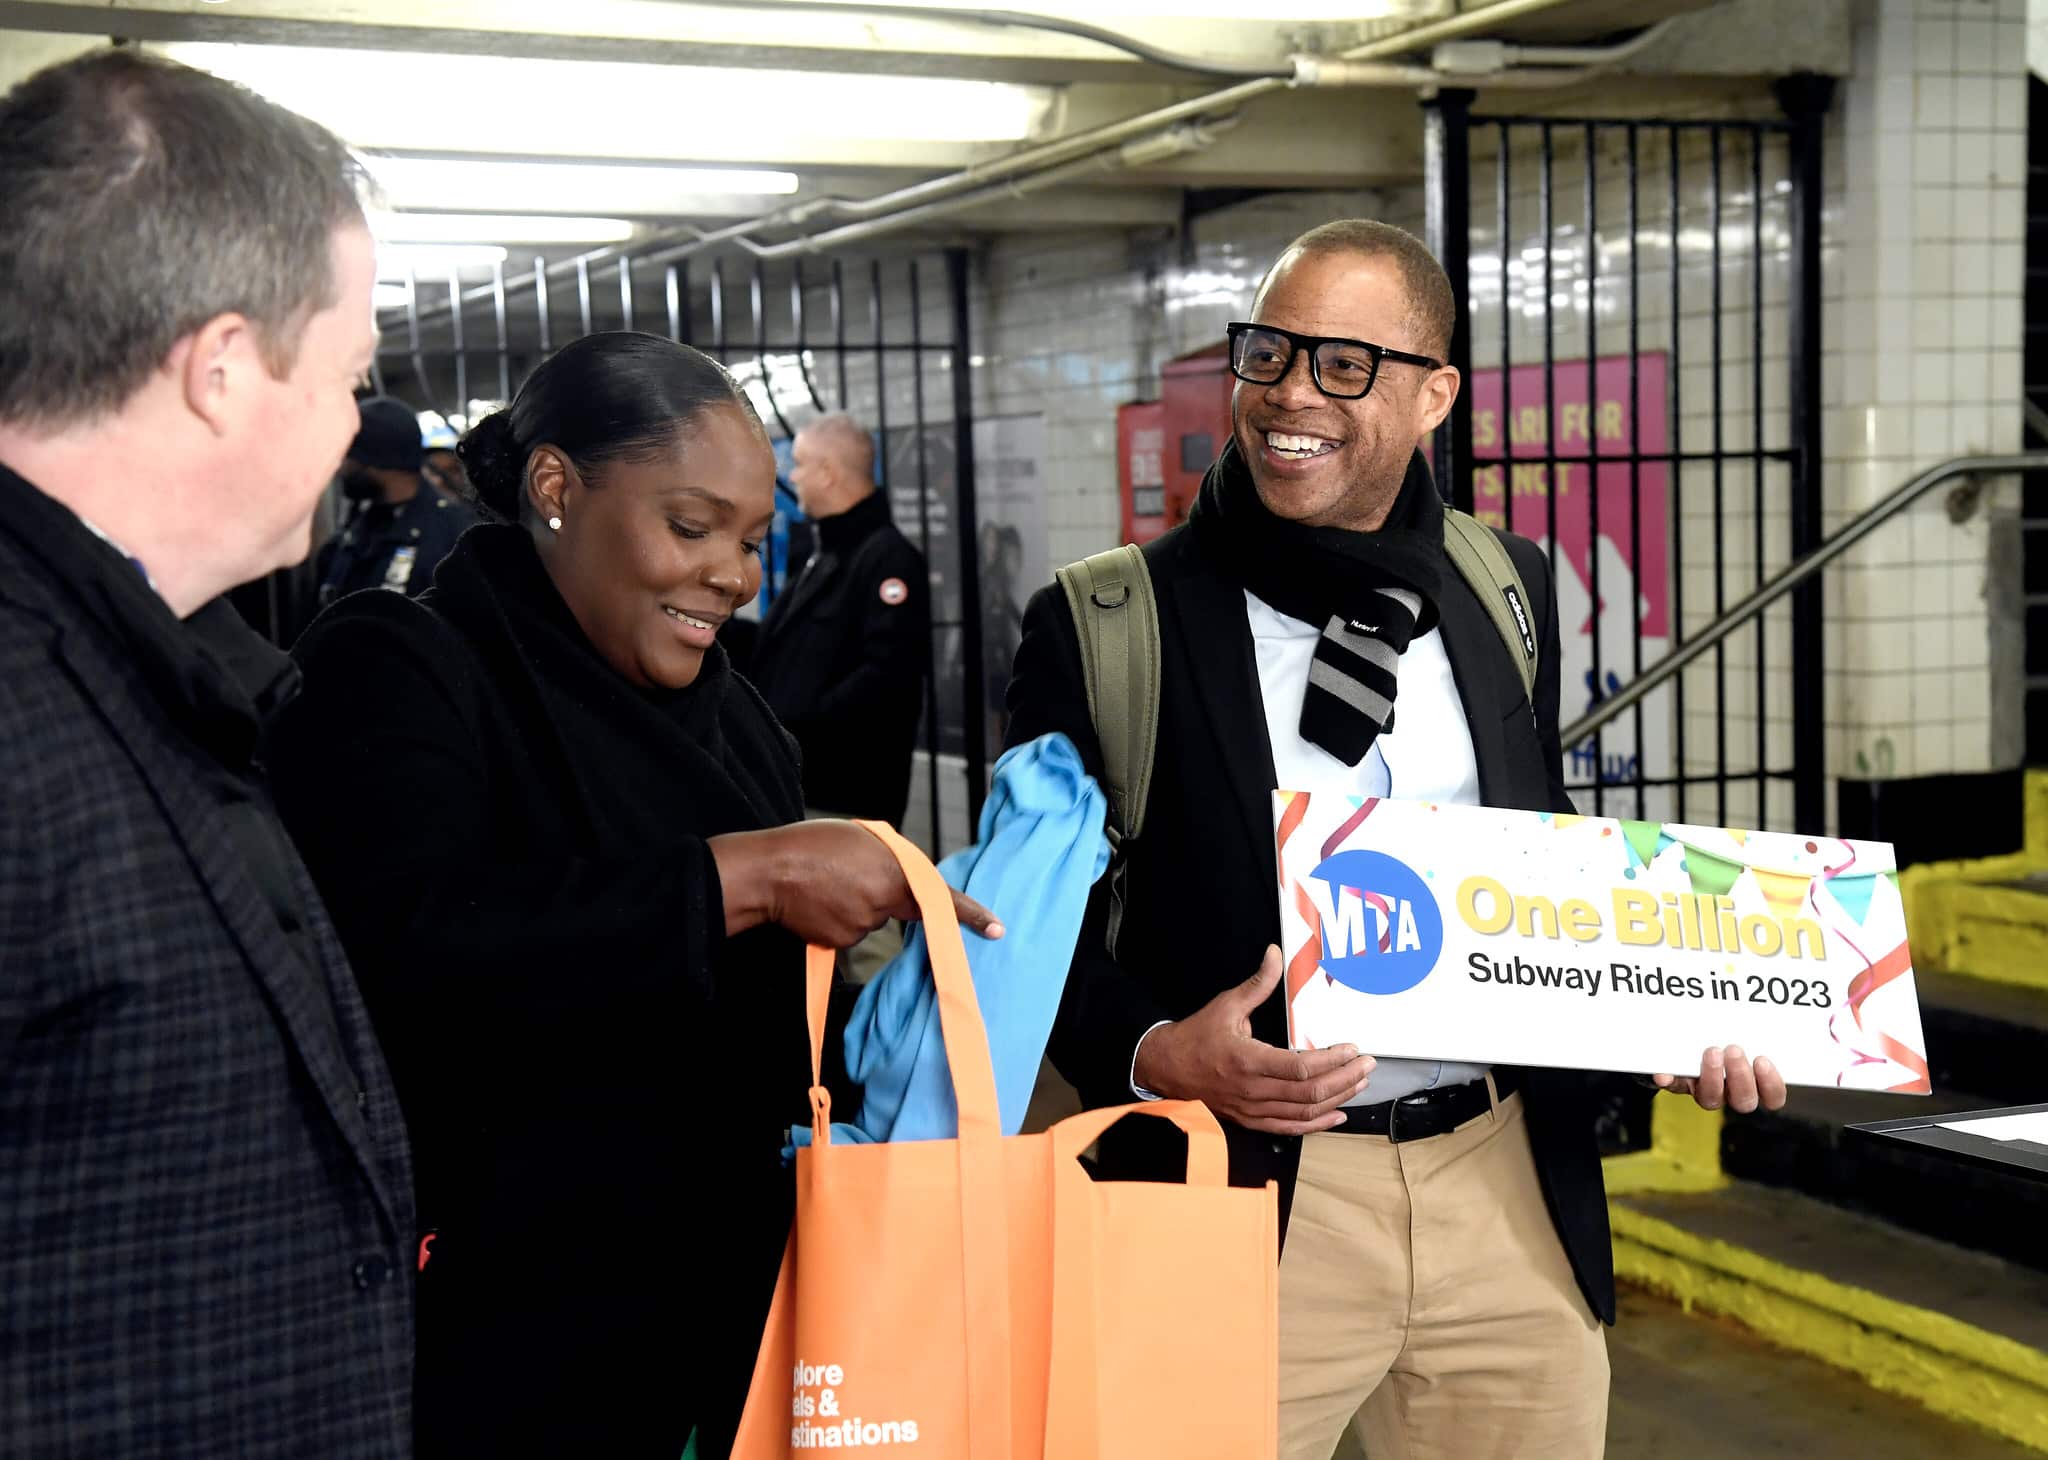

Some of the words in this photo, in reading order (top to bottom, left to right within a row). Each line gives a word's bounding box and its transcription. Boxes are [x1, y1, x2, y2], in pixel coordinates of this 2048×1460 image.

[1561, 401, 1623, 442] FOR
[1508, 591, 1528, 635] adidas
[1309, 875, 1422, 961] MTA
[1455, 875, 1603, 943] One
[1611, 887, 1827, 961] Billion
[1468, 952, 1602, 997] Subway
[1610, 962, 1704, 999] Rides
[1709, 971, 1740, 1001] in
[1746, 975, 1832, 1009] 2023
[818, 1388, 840, 1417] &
